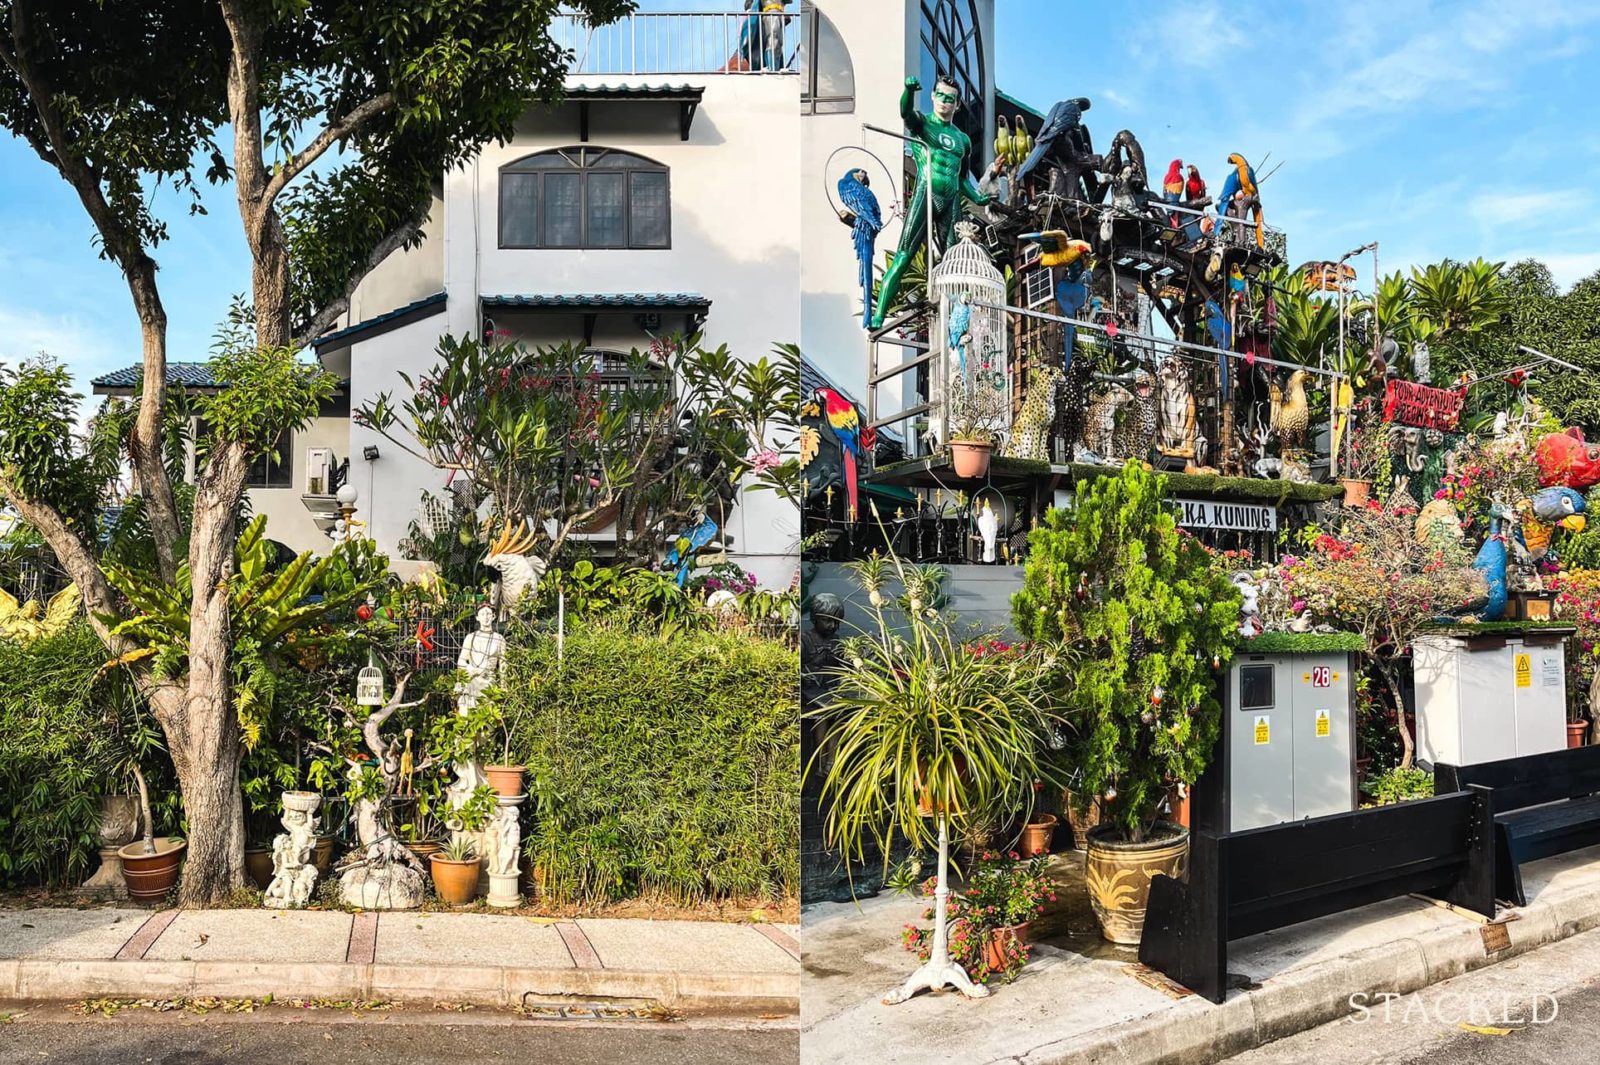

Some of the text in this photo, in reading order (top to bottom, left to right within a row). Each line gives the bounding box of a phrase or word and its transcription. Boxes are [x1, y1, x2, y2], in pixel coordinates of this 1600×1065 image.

[1394, 381, 1413, 402] YOUR
[1213, 505, 1270, 529] KUNING
[1314, 667, 1330, 687] 28
